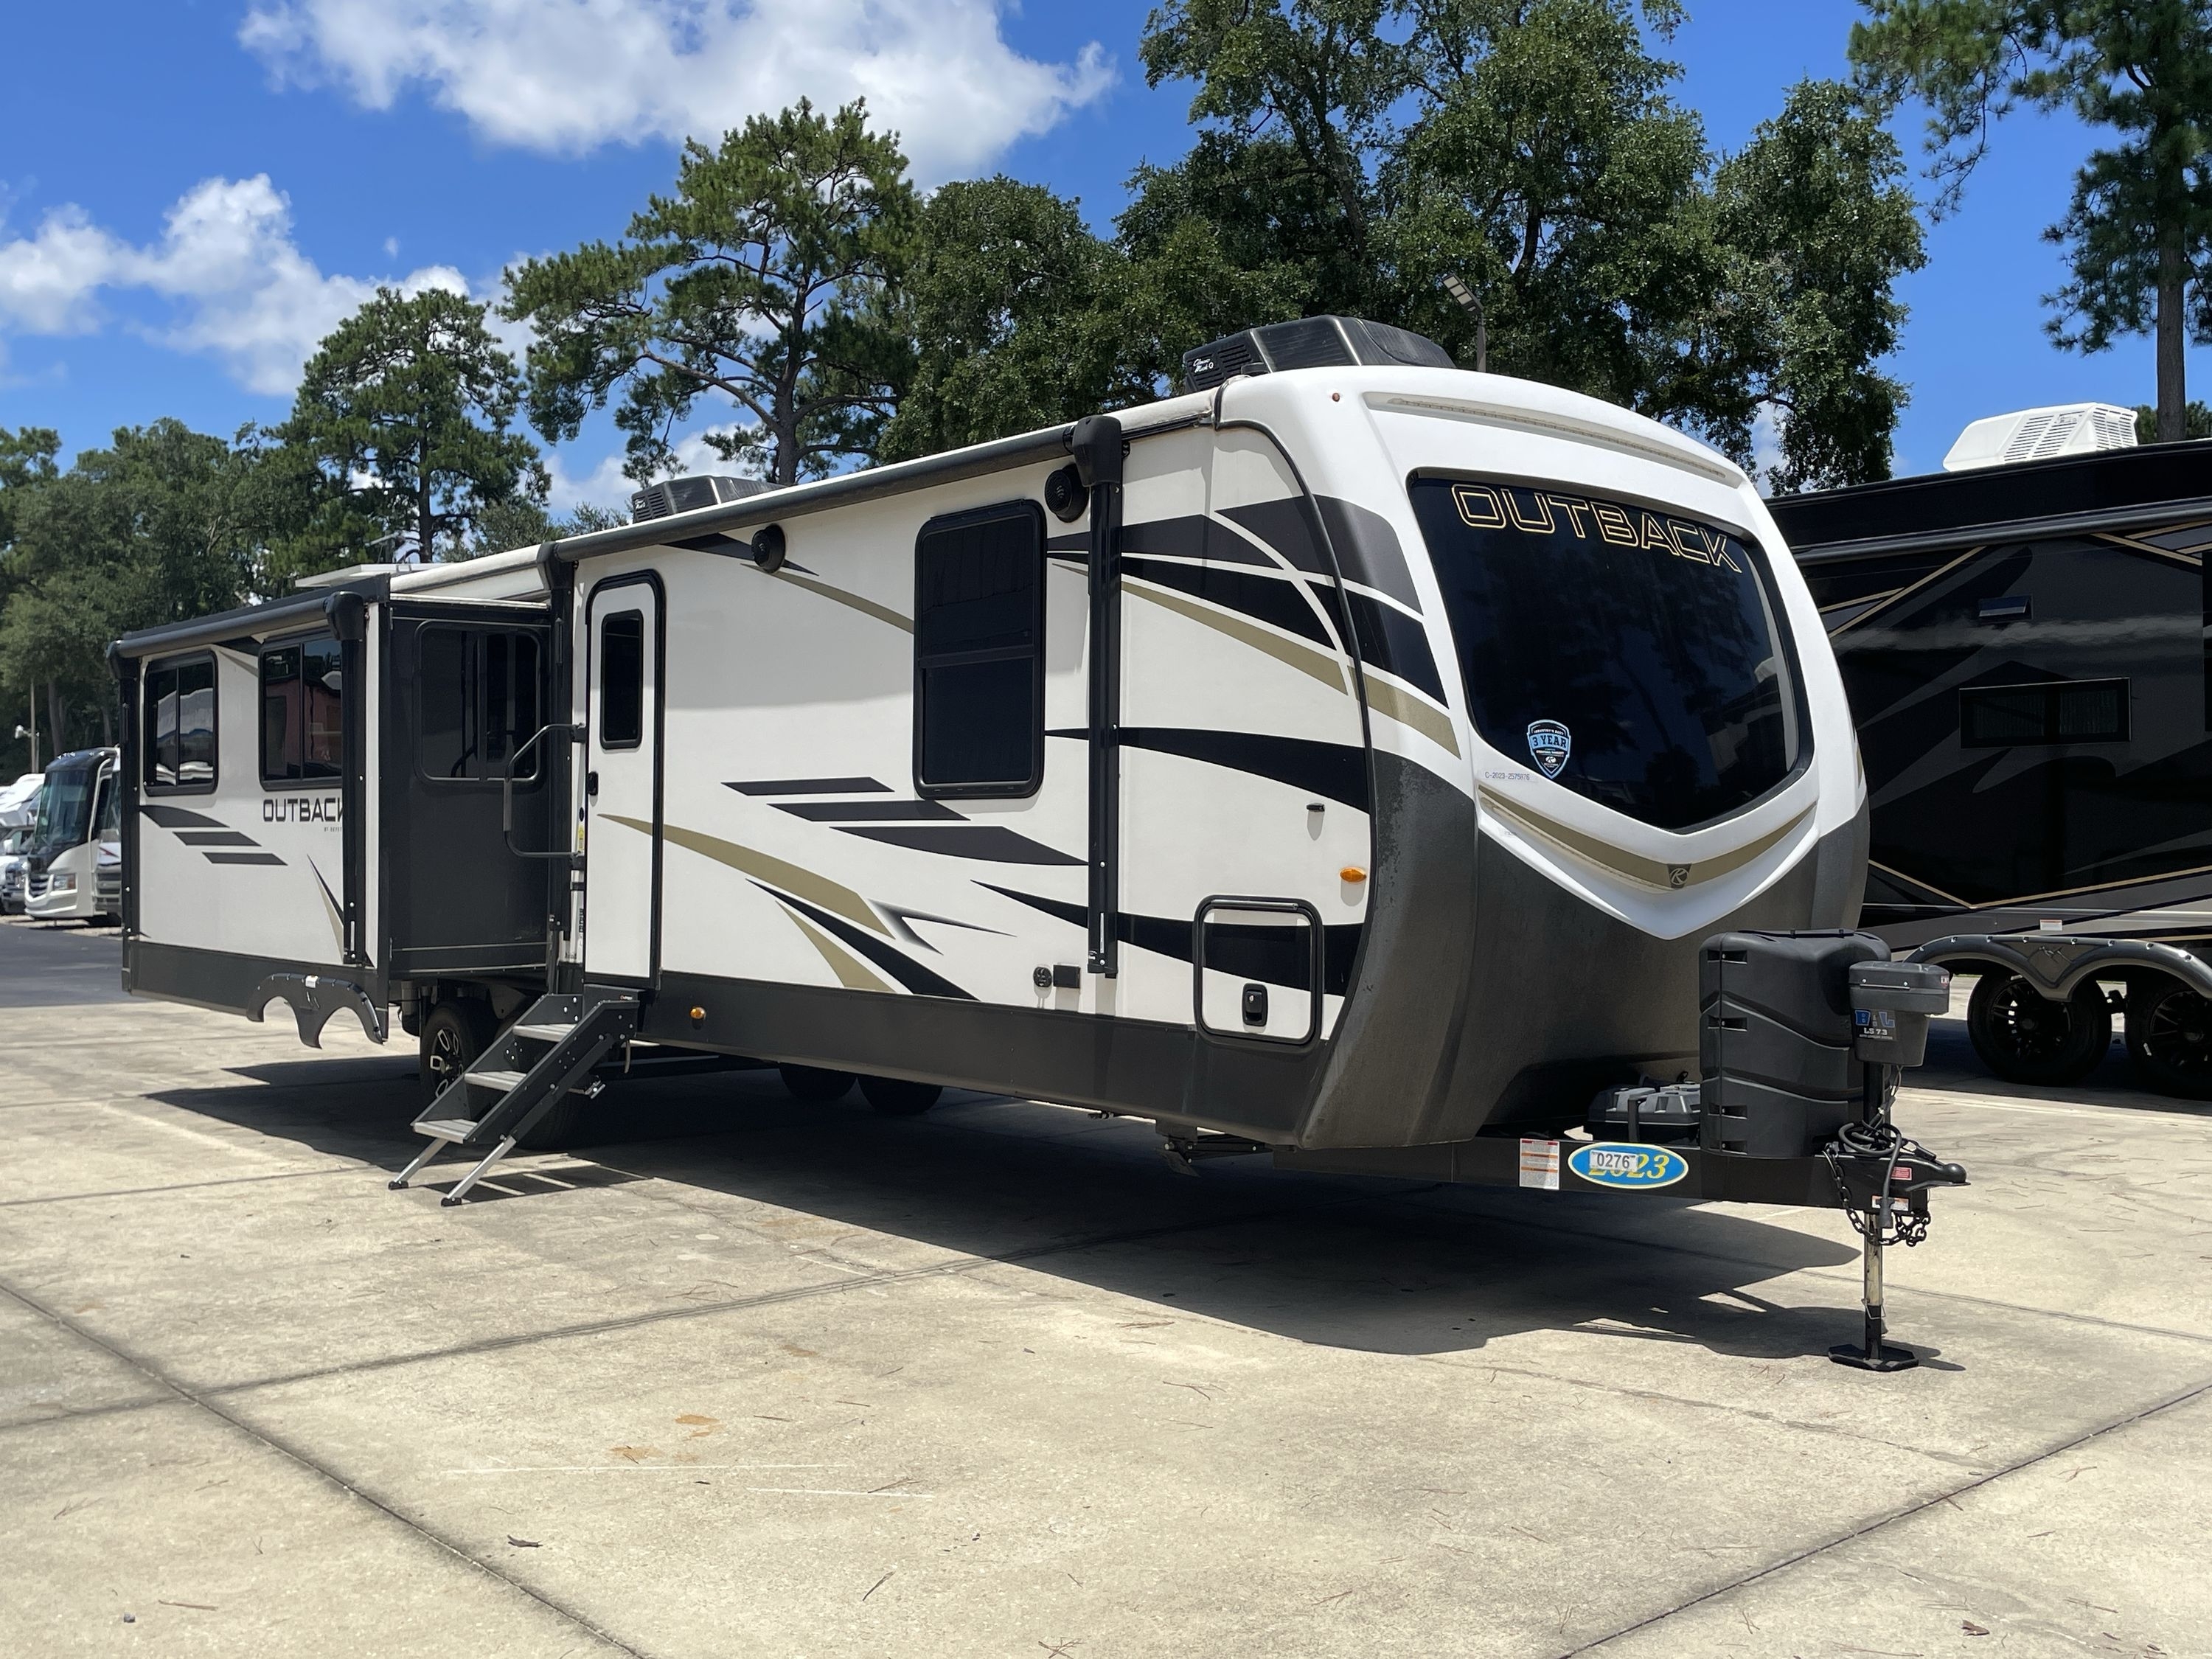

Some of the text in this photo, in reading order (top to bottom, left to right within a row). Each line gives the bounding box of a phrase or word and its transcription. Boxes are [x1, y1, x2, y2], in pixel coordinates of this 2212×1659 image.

[1451, 484, 1742, 573] OUTBACK
[1532, 735, 1567, 748] 3 YEAR
[1589, 1153, 1669, 1179] 23
[1597, 1152, 1630, 1169] 0276
